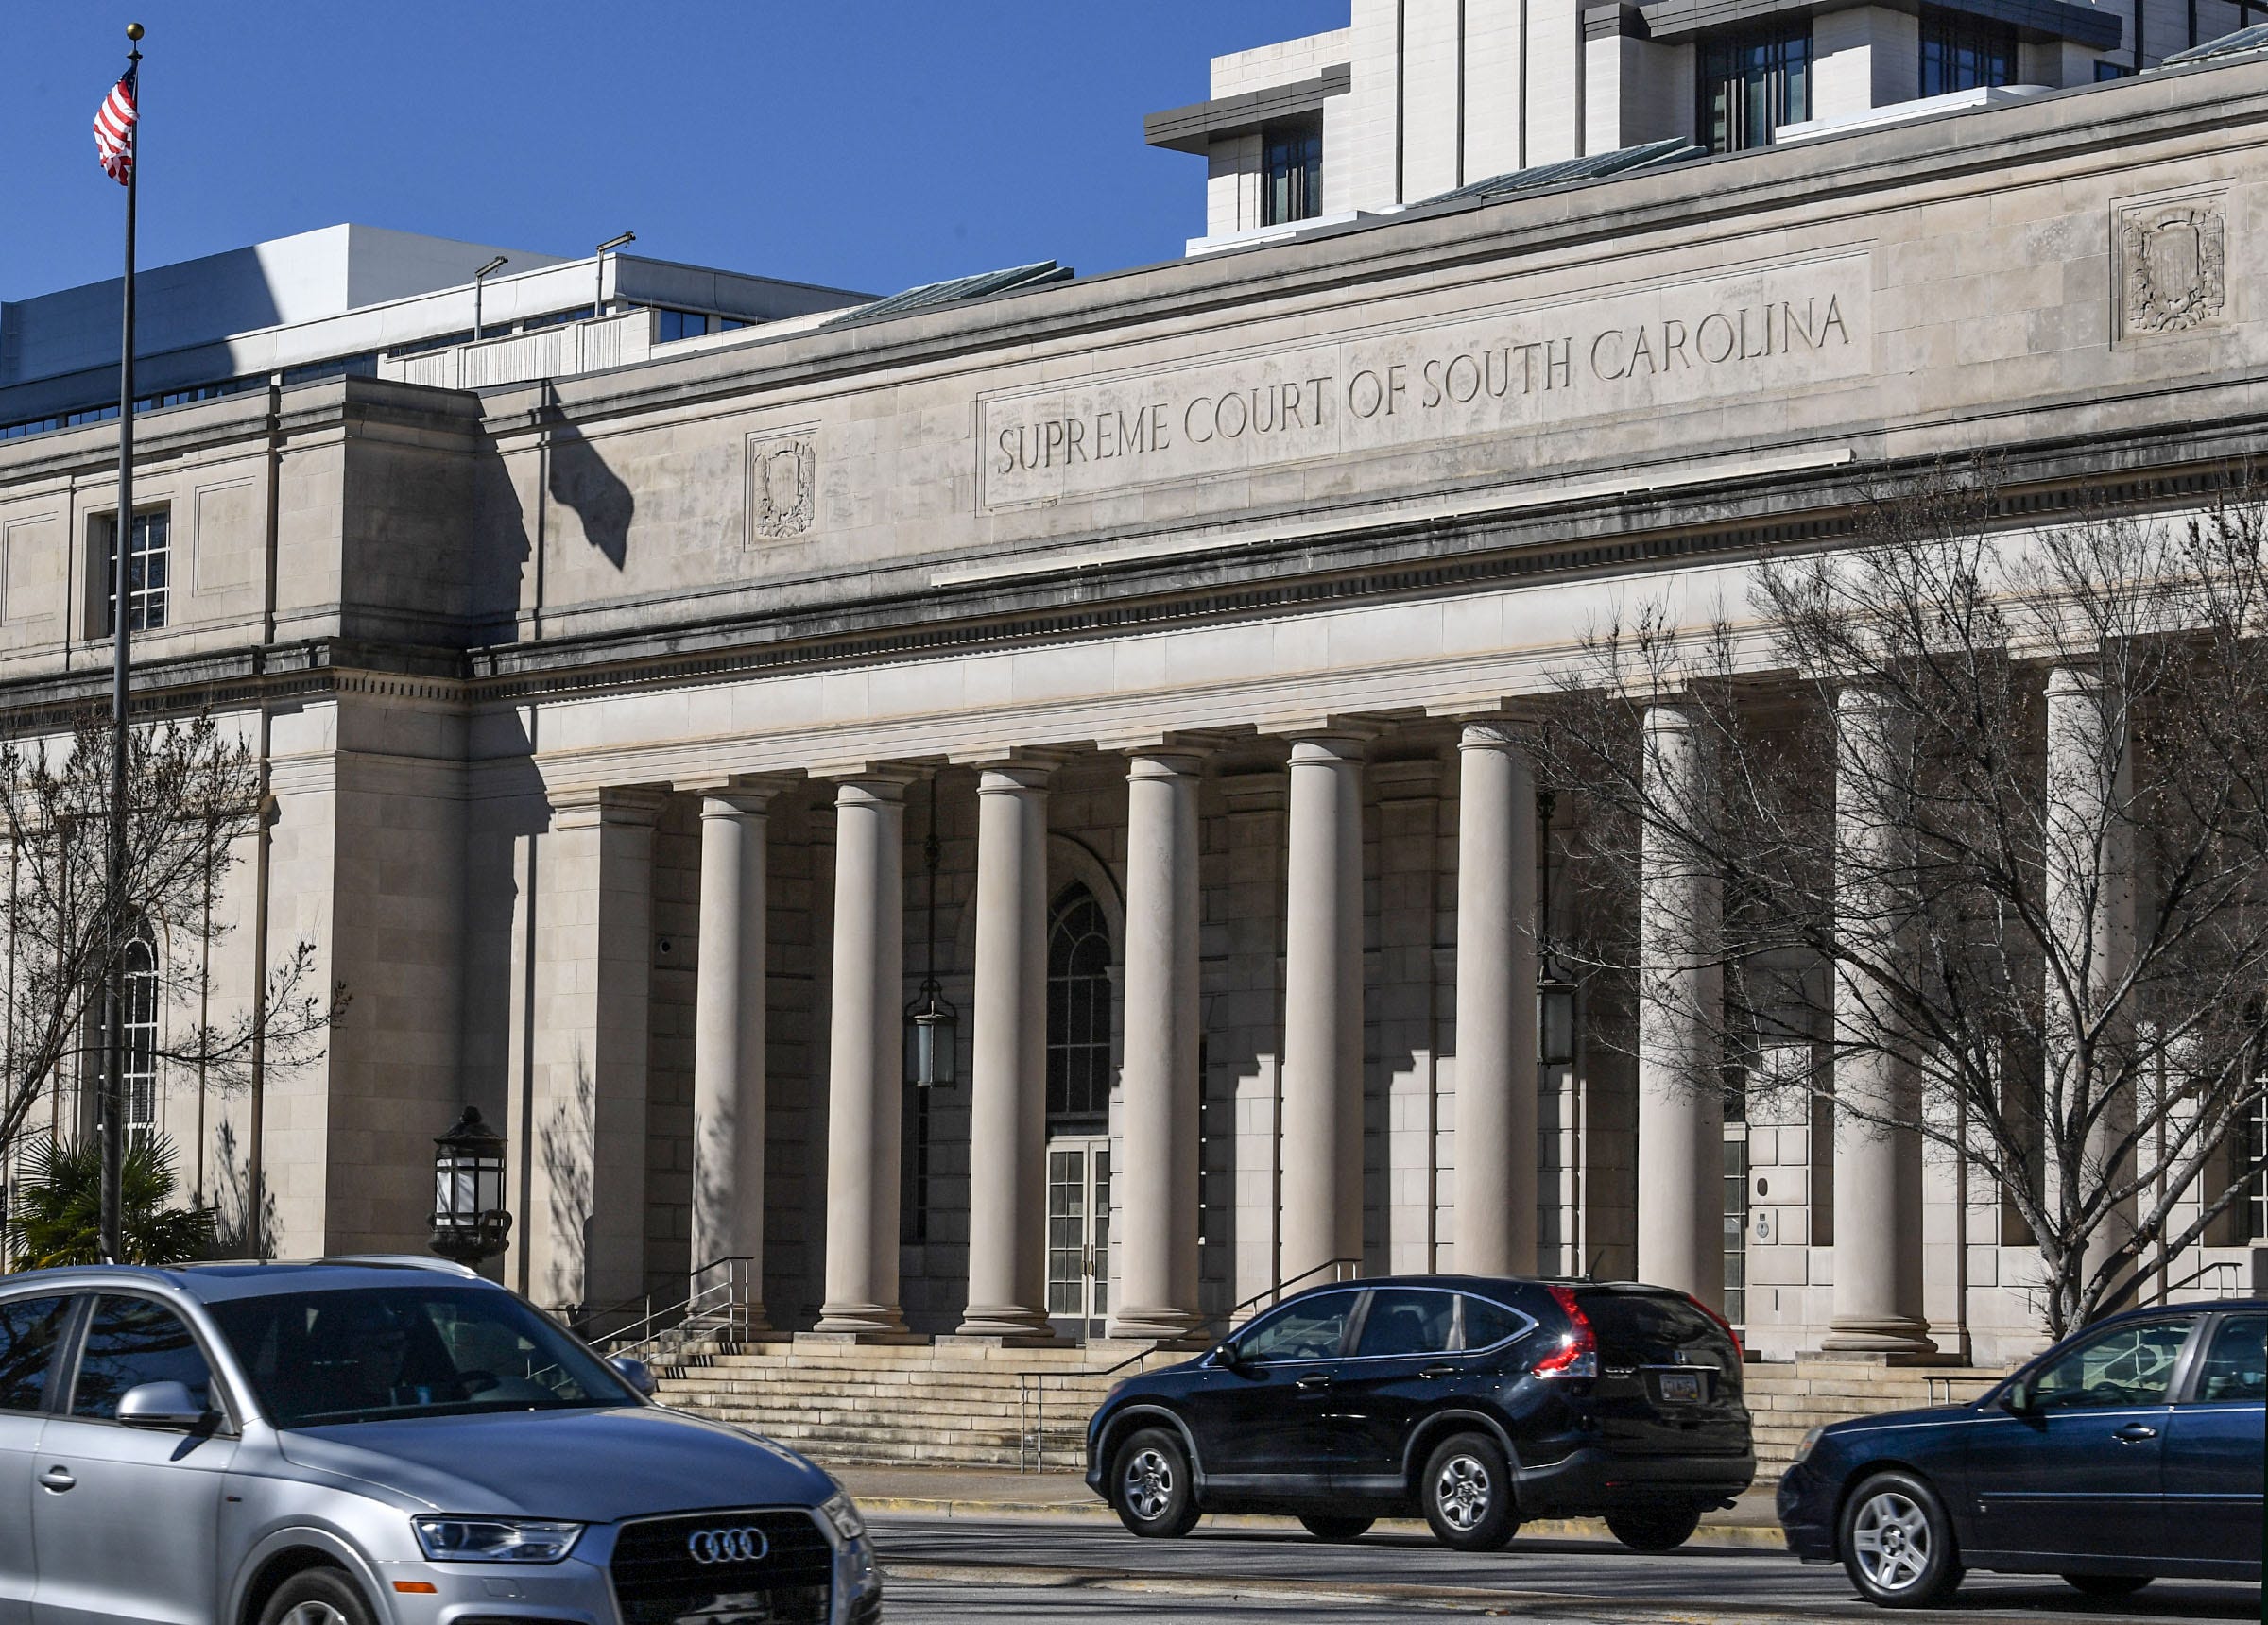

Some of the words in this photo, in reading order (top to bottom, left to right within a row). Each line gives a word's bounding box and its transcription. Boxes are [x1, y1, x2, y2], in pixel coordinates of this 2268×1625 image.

[998, 403, 1170, 473] SUPREME
[1184, 376, 1332, 444] COURT
[1348, 365, 1407, 419] OF
[1422, 336, 1572, 409] SOUTH
[1590, 294, 1851, 381] CAROLINA
